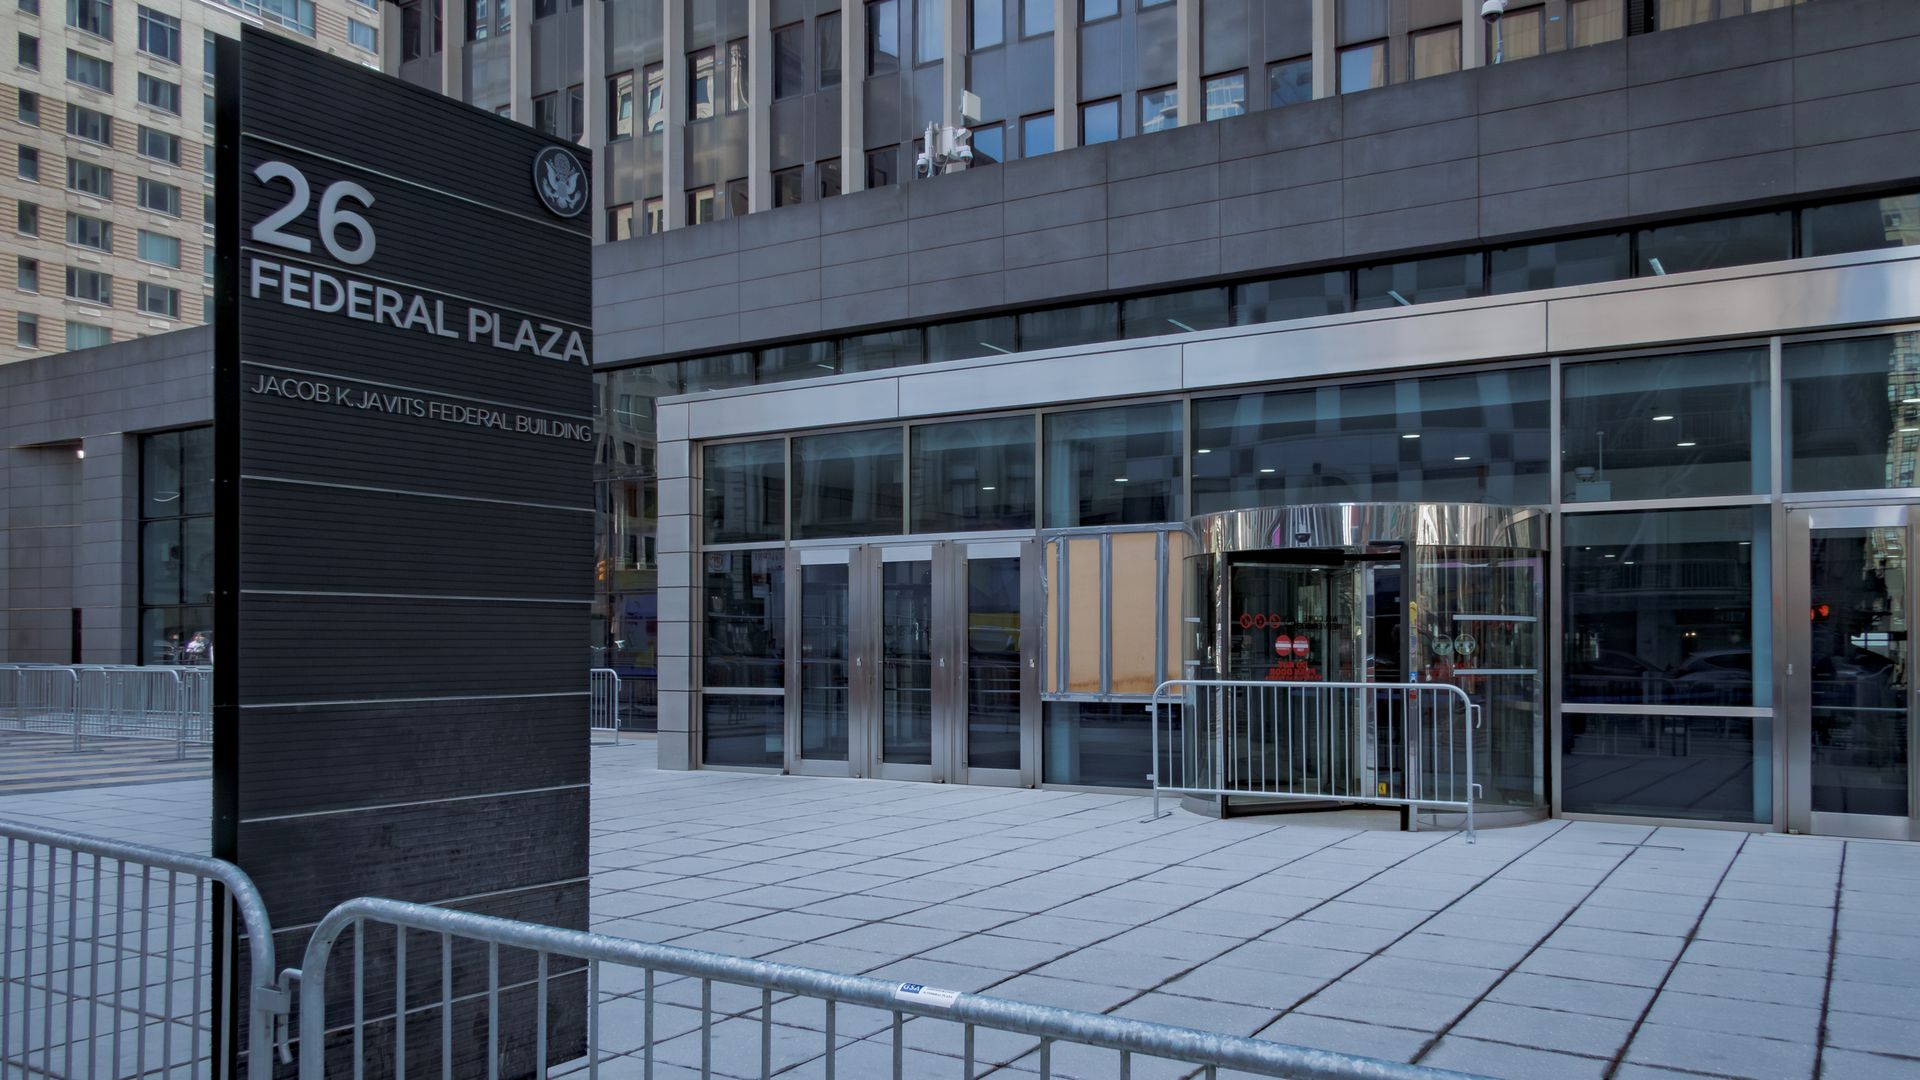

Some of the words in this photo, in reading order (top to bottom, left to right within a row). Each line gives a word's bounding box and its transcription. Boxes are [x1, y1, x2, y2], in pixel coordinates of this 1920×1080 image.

[252, 161, 376, 265] 26
[251, 258, 459, 339] FEDERAL
[467, 307, 590, 366] PLAZA
[251, 374, 331, 403] JACOB
[335, 386, 354, 407] K.
[356, 391, 426, 418] JAVITS
[428, 401, 513, 431] FEDERAL
[515, 415, 592, 442] BUILDING
[902, 983, 921, 992] GSA
